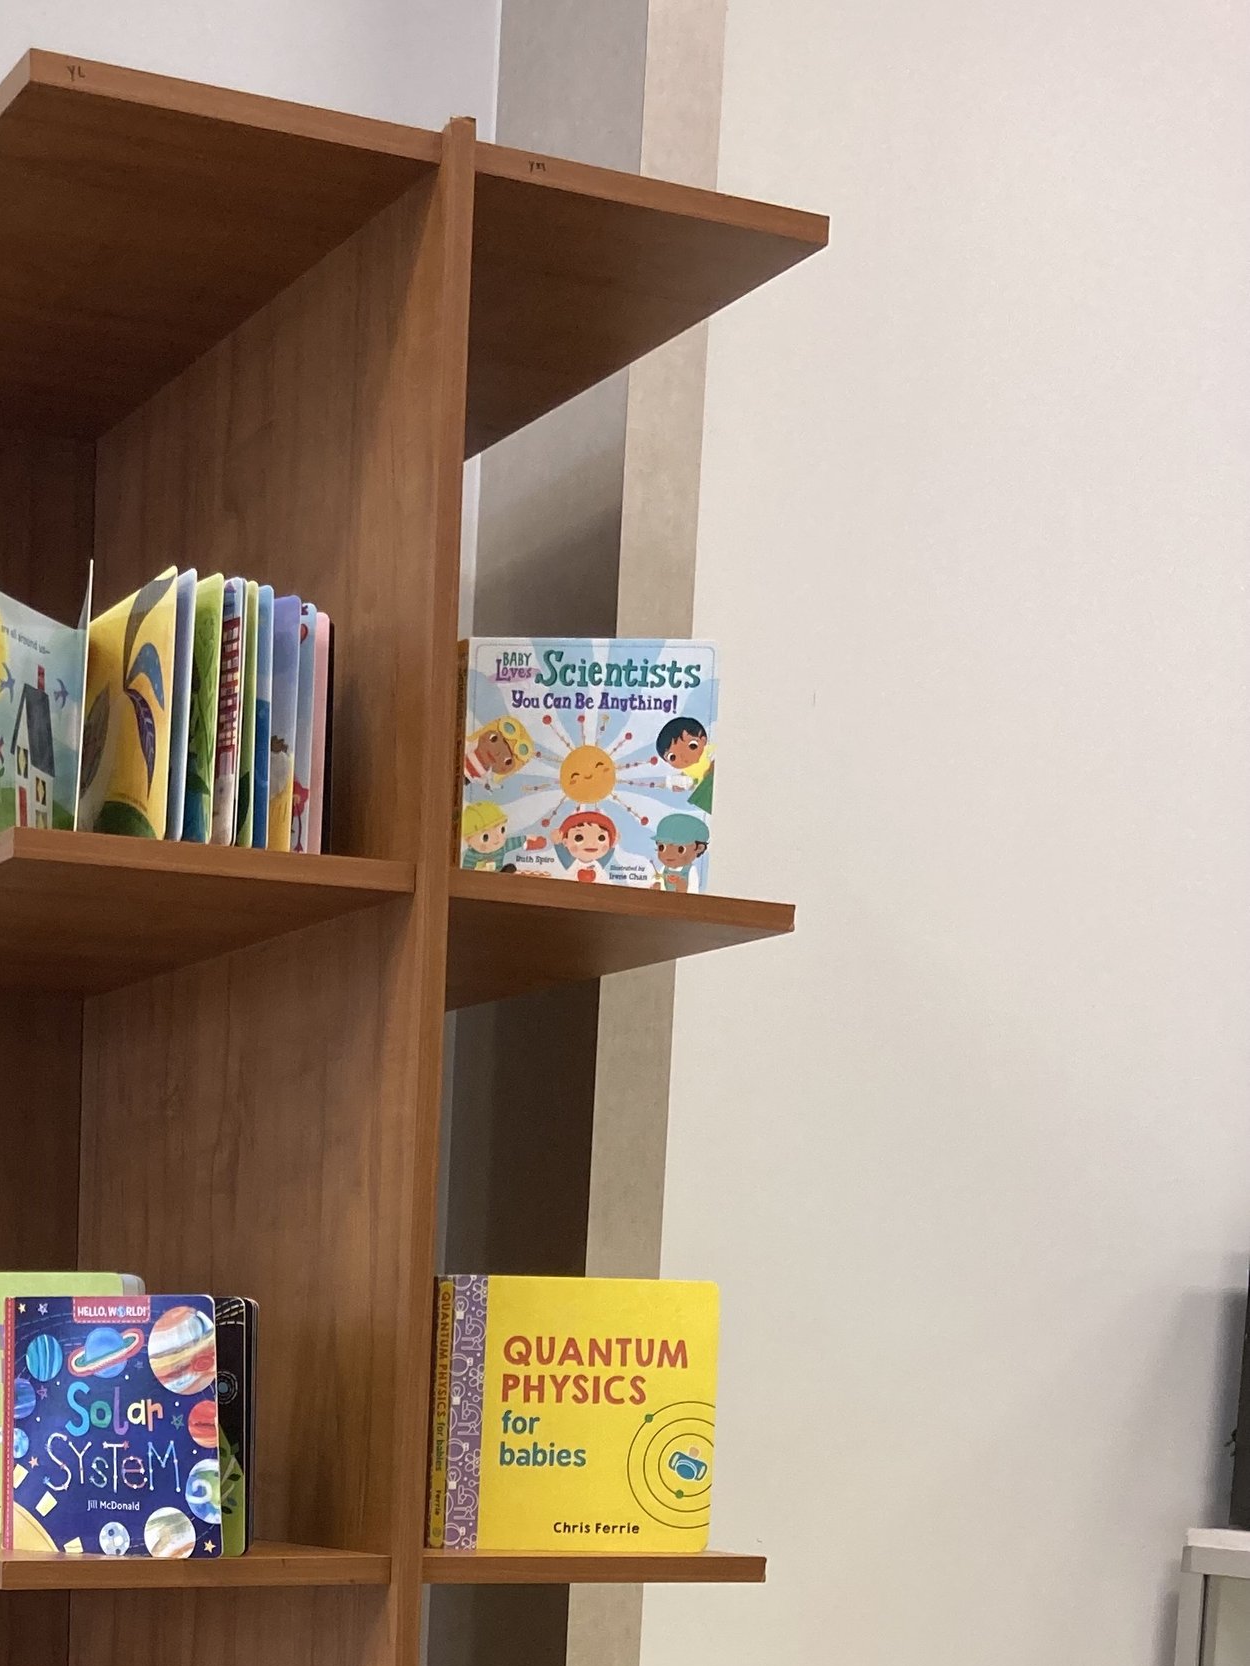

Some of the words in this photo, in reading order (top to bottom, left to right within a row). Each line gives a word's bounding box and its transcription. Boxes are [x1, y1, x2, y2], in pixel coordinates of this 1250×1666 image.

[495, 658, 532, 682] Loves
[503, 652, 532, 667] BABY
[535, 650, 701, 688] Scientists
[512, 690, 540, 709] You
[543, 692, 570, 710] Can
[575, 692, 594, 710] Be
[597, 692, 678, 714] Anything!
[516, 855, 534, 863] Ruth
[535, 855, 555, 865] Spiro
[628, 873, 648, 881] Chan
[77, 1306, 107, 1317] HELLO,
[108, 1306, 146, 1318] WORLD!
[439, 1291, 450, 1360] QUANTUM
[503, 1335, 688, 1369] QUANTUM
[437, 1363, 448, 1417] PHYSICS
[501, 1374, 647, 1405] PHYSICS
[64, 1381, 163, 1437] Solar
[437, 1422, 445, 1436] for
[501, 1410, 540, 1435] for
[436, 1440, 444, 1471] babies
[499, 1441, 587, 1467] babies
[87, 1500, 98, 1511] Jill
[100, 1500, 140, 1511] McDonald
[553, 1521, 591, 1534] Chris
[595, 1522, 639, 1534] Ferrie
